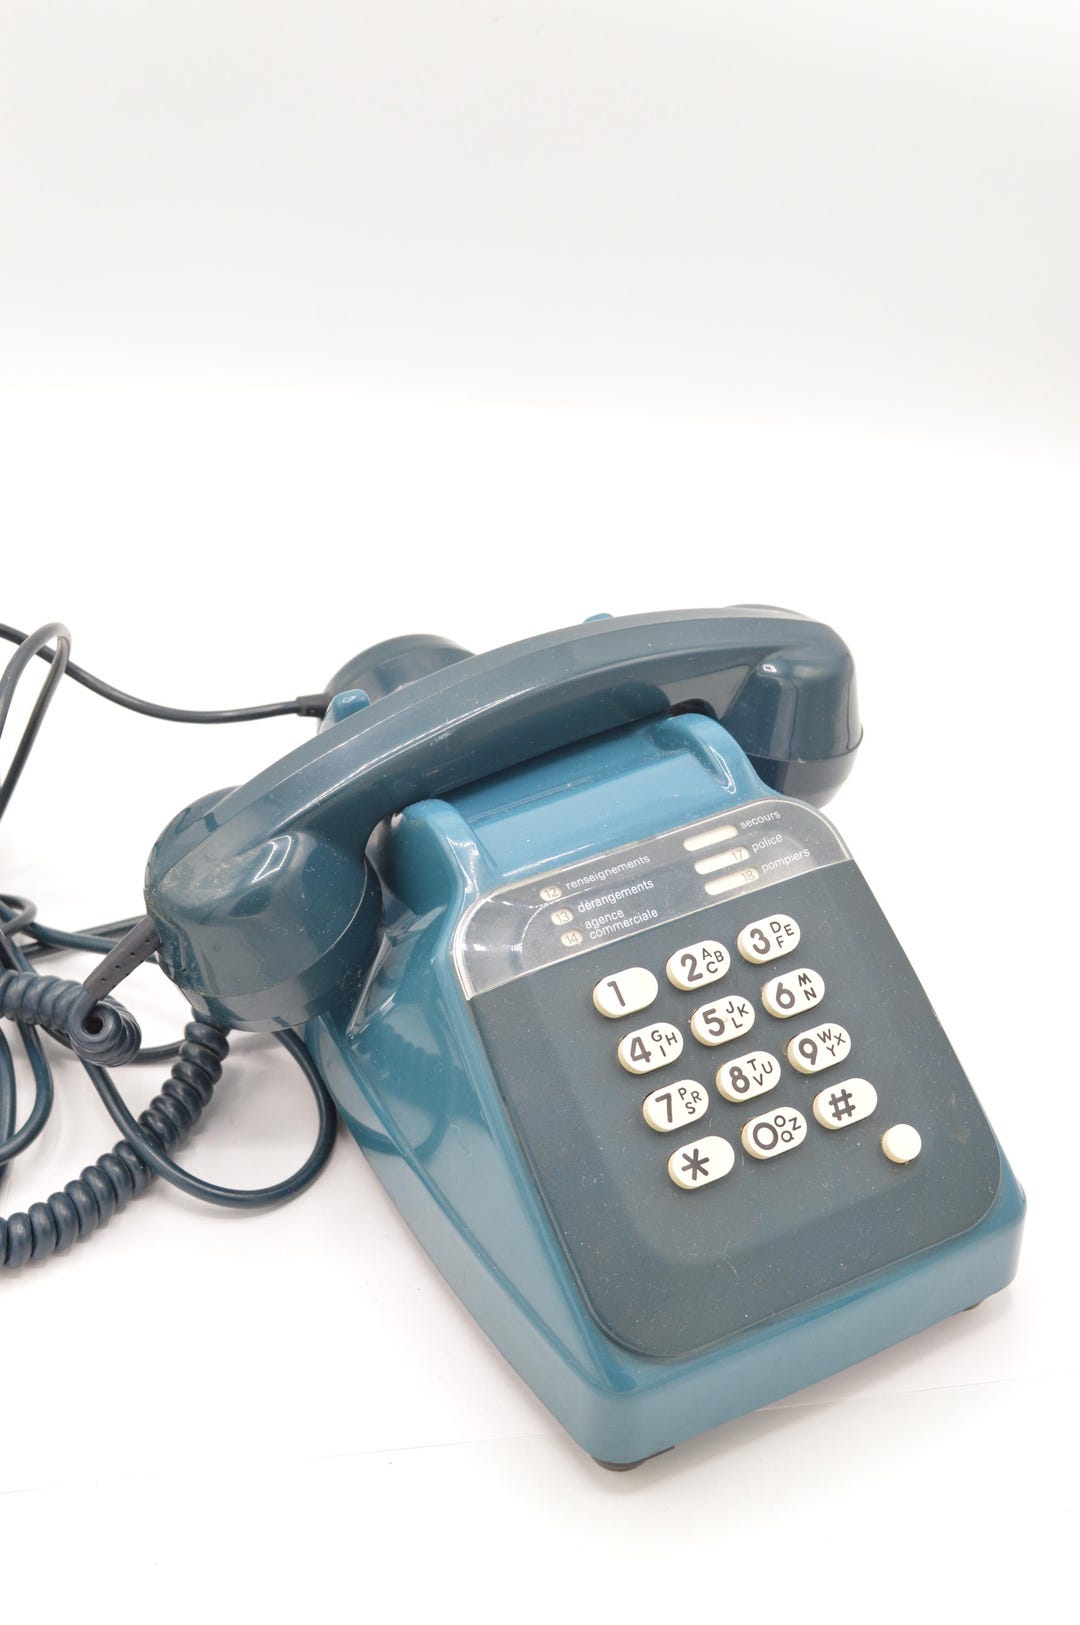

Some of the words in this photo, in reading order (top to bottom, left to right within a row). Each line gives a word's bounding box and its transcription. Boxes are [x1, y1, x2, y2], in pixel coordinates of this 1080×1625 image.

[739, 811, 781, 829] secours
[731, 849, 743, 861] 17
[752, 833, 783, 853] police
[545, 887, 559, 899] 12
[566, 855, 651, 890] renseignements
[742, 870, 755, 882] 18
[761, 848, 811, 874] pompiers
[556, 911, 570, 923] 13
[577, 880, 655, 913] dérangements
[565, 933, 580, 945] 14
[589, 909, 659, 940] commerciale
[584, 909, 625, 929] agence
[750, 928, 771, 955] 3
[680, 953, 704, 982] 2
[607, 980, 626, 1007] 1
[775, 982, 796, 1010] 6
[702, 1008, 725, 1037] 5
[630, 1036, 652, 1063] 4
[798, 1038, 818, 1066] 9
[729, 1066, 750, 1094] 8
[654, 1092, 673, 1123] 7
